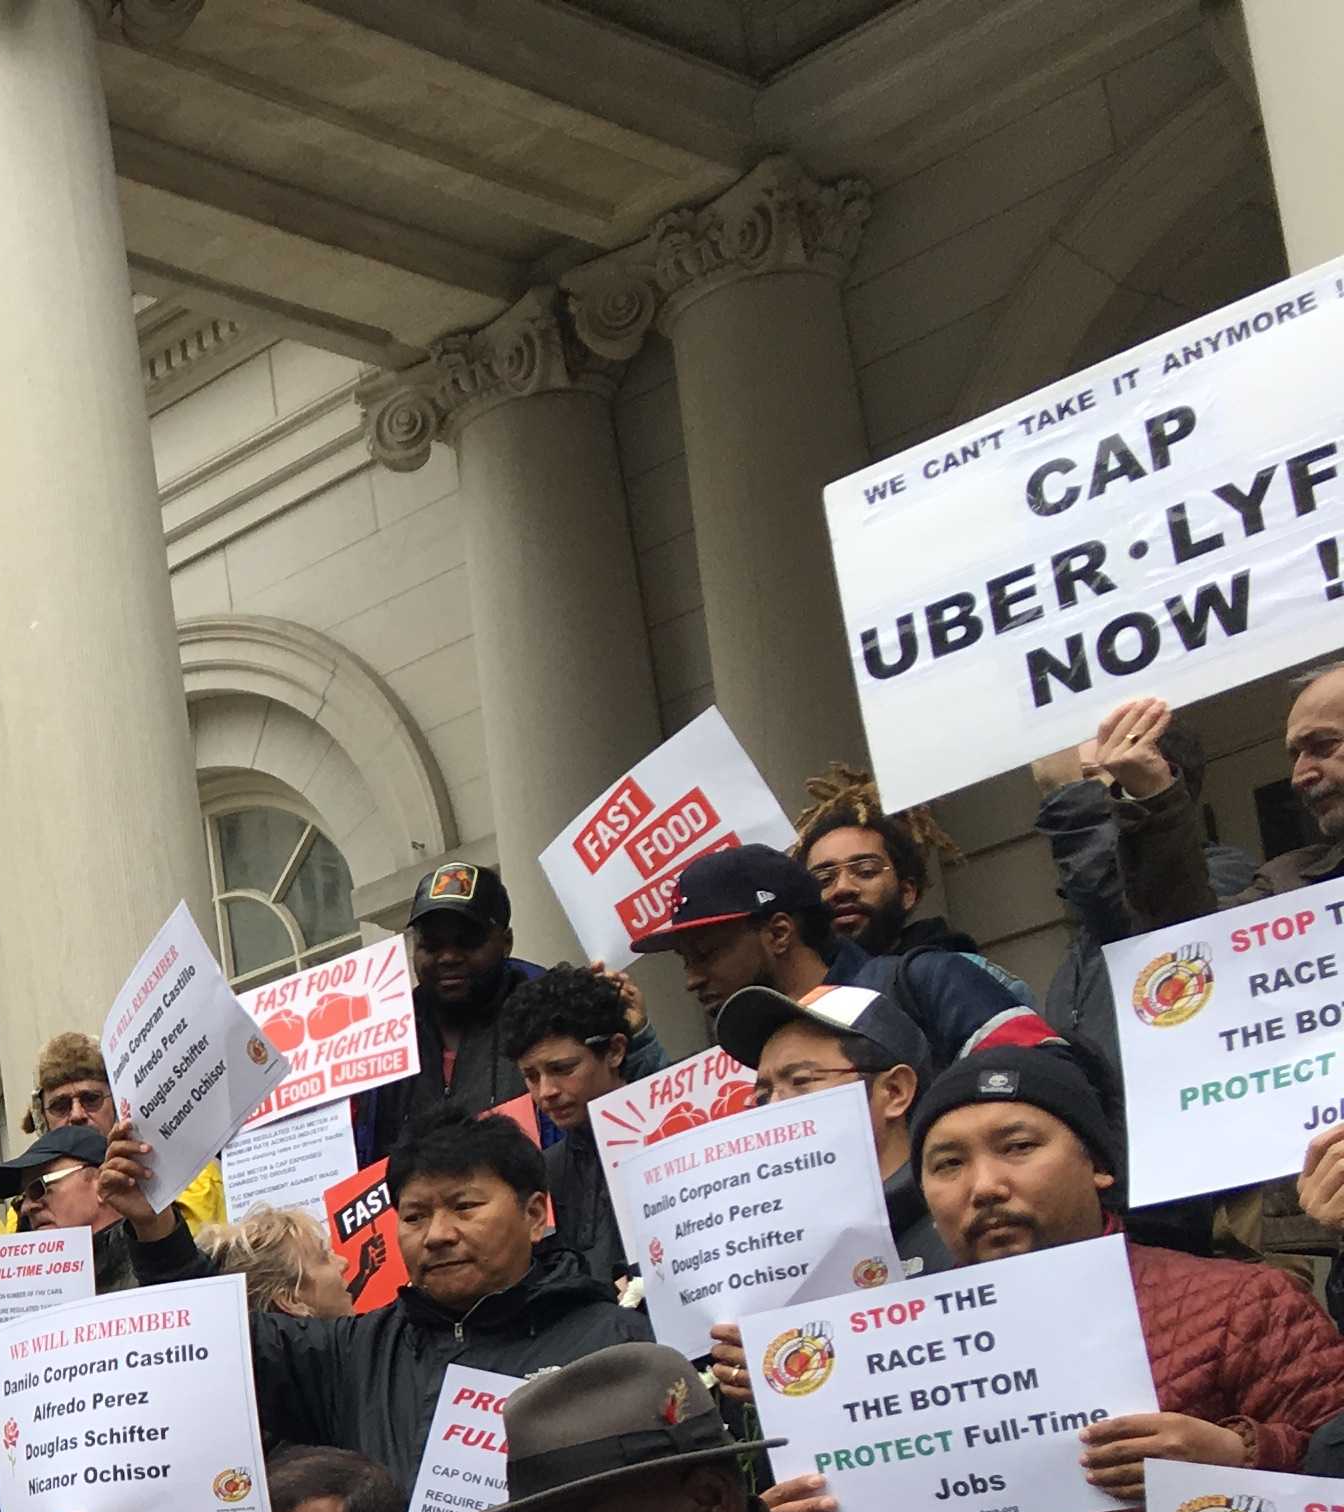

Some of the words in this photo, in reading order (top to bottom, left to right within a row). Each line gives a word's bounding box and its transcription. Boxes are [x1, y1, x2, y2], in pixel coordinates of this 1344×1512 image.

[863, 474, 907, 505] WE
[922, 430, 1006, 481] CAN'T
[1018, 390, 1097, 437] TAKE
[1112, 368, 1140, 396] IT
[1161, 292, 1318, 375] ANYMORE
[1025, 405, 1196, 518] CAP
[1026, 569, 1251, 708] NOW
[582, 788, 641, 862] FAST
[635, 801, 708, 869] FOOD
[1230, 910, 1315, 952] STOP
[131, 945, 178, 1013] REMEMBER
[254, 978, 302, 1015] FAST
[306, 959, 357, 996] FOOD
[1249, 954, 1338, 997] RACE
[128, 1006, 163, 1054] Corporan
[163, 965, 195, 1008] Castillo
[1220, 1017, 1284, 1051] THE
[134, 1047, 163, 1087] Alfredo
[161, 1017, 188, 1049] Perez
[314, 1013, 411, 1065] FIGHTERS
[140, 1076, 175, 1119] Douglas
[172, 1034, 210, 1079] Schifter
[159, 1099, 194, 1140] Nicanor
[191, 1059, 227, 1102] Ochisor
[280, 1078, 320, 1106] FOOD
[335, 1051, 403, 1081] JUSTICE
[649, 1064, 698, 1110] FAST
[1181, 1052, 1336, 1111] PROTECT
[643, 1167, 662, 1186] WE
[663, 1151, 700, 1179] WILL
[704, 1119, 817, 1163] REMEMBER
[643, 1193, 676, 1220] Danilo
[680, 1171, 750, 1205] Corporan
[757, 1151, 836, 1180] Castillo
[675, 1212, 724, 1240] Alfredo
[729, 1197, 783, 1221] Perez
[38, 1240, 64, 1254] OUR
[46, 1260, 84, 1275] JOBS!
[672, 1249, 720, 1276] Douglas
[726, 1228, 804, 1256] Schifter
[679, 1280, 723, 1306] Nicanor
[728, 1260, 809, 1290] Ochisor
[850, 1299, 925, 1333] STOP
[935, 1284, 997, 1315] THE
[10, 1340, 29, 1361] WE
[32, 1330, 68, 1357] WILL
[74, 1308, 191, 1343] REMEMBER
[867, 1340, 945, 1374] RACE
[954, 1331, 996, 1357] TO
[3, 1373, 39, 1397] Danilo
[43, 1356, 118, 1384] Corporan
[126, 1343, 208, 1369] Castillo
[844, 1392, 902, 1423] THE
[912, 1368, 1039, 1413] BOTTOM
[33, 1396, 86, 1423] Alfredo
[92, 1390, 149, 1409] Perez
[25, 1435, 78, 1461] Douglas
[84, 1424, 169, 1447] Schifter
[815, 1431, 953, 1474] PROTECT
[964, 1407, 1108, 1449] Full-Time
[29, 1470, 77, 1496] Nicanor
[84, 1462, 171, 1484] Ochisor
[425, 1489, 483, 1511] REQUIRE
[432, 1465, 459, 1478] CAP
[463, 1472, 482, 1484] ON
[935, 1474, 1006, 1500] Jobs
